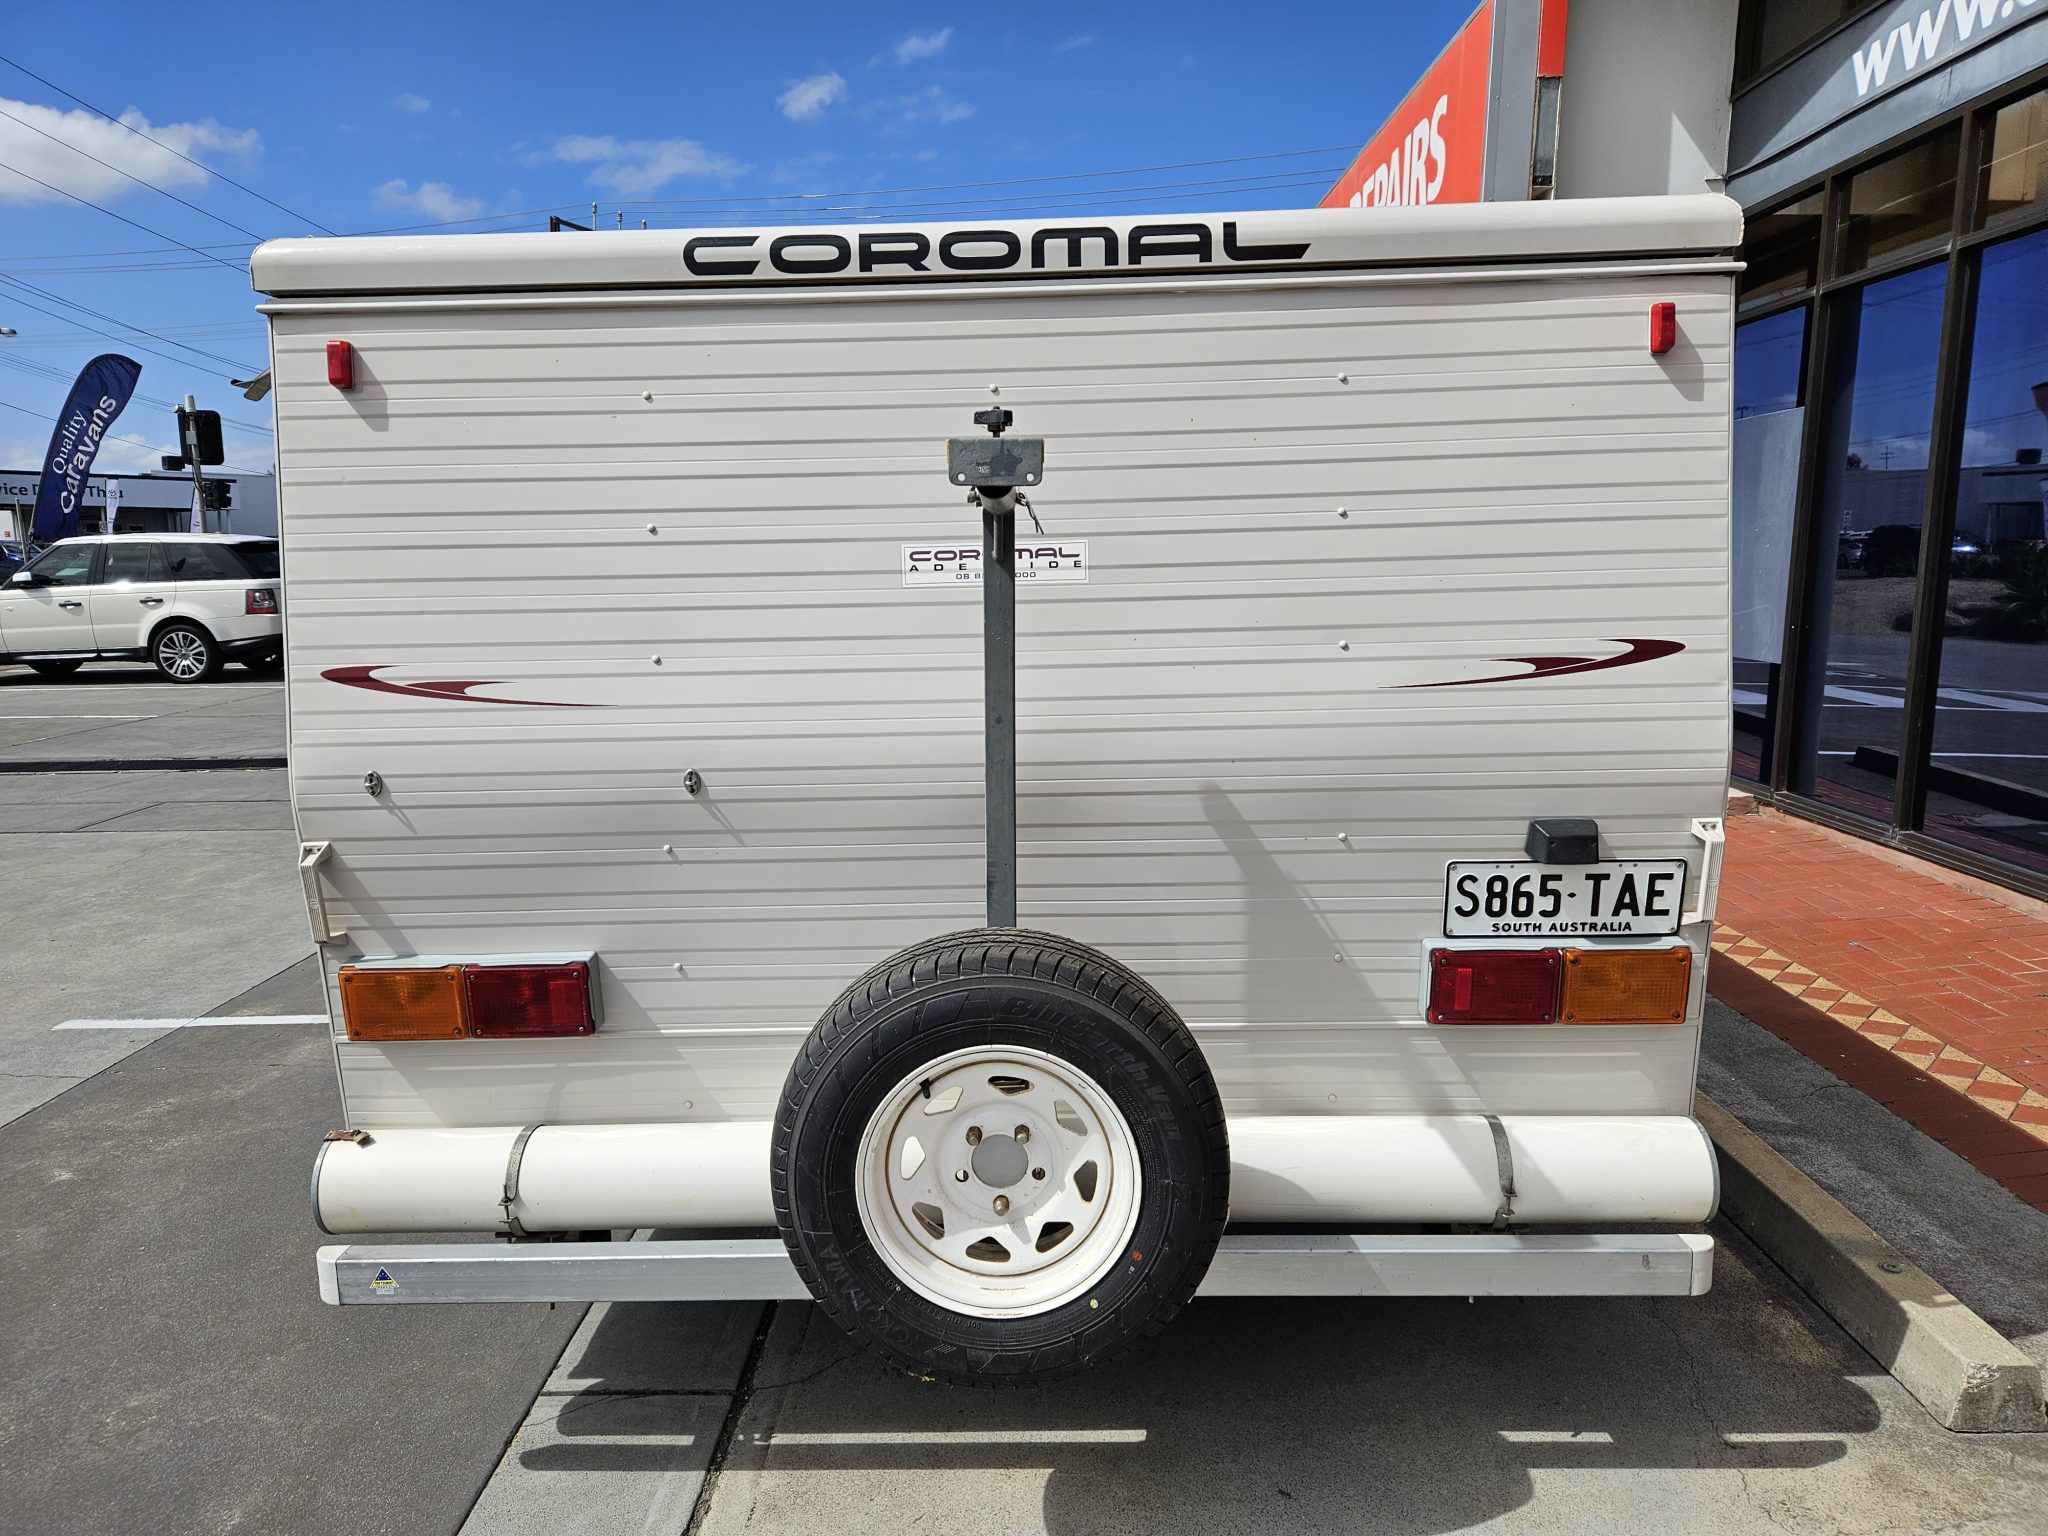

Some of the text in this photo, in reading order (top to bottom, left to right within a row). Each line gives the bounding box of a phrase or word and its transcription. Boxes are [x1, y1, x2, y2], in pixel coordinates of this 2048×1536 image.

[1852, 0, 2036, 97] www.
[1350, 94, 1448, 208] PAIRS
[683, 221, 1311, 276] COROMAL
[52, 410, 87, 475] Quality
[60, 395, 117, 514] Caravans
[0, 483, 28, 496] ice
[909, 547, 1080, 561] CORMAL
[909, 561, 1082, 572] ADEIDE
[1491, 921, 1633, 933] SOUTH AUSTRALIA
